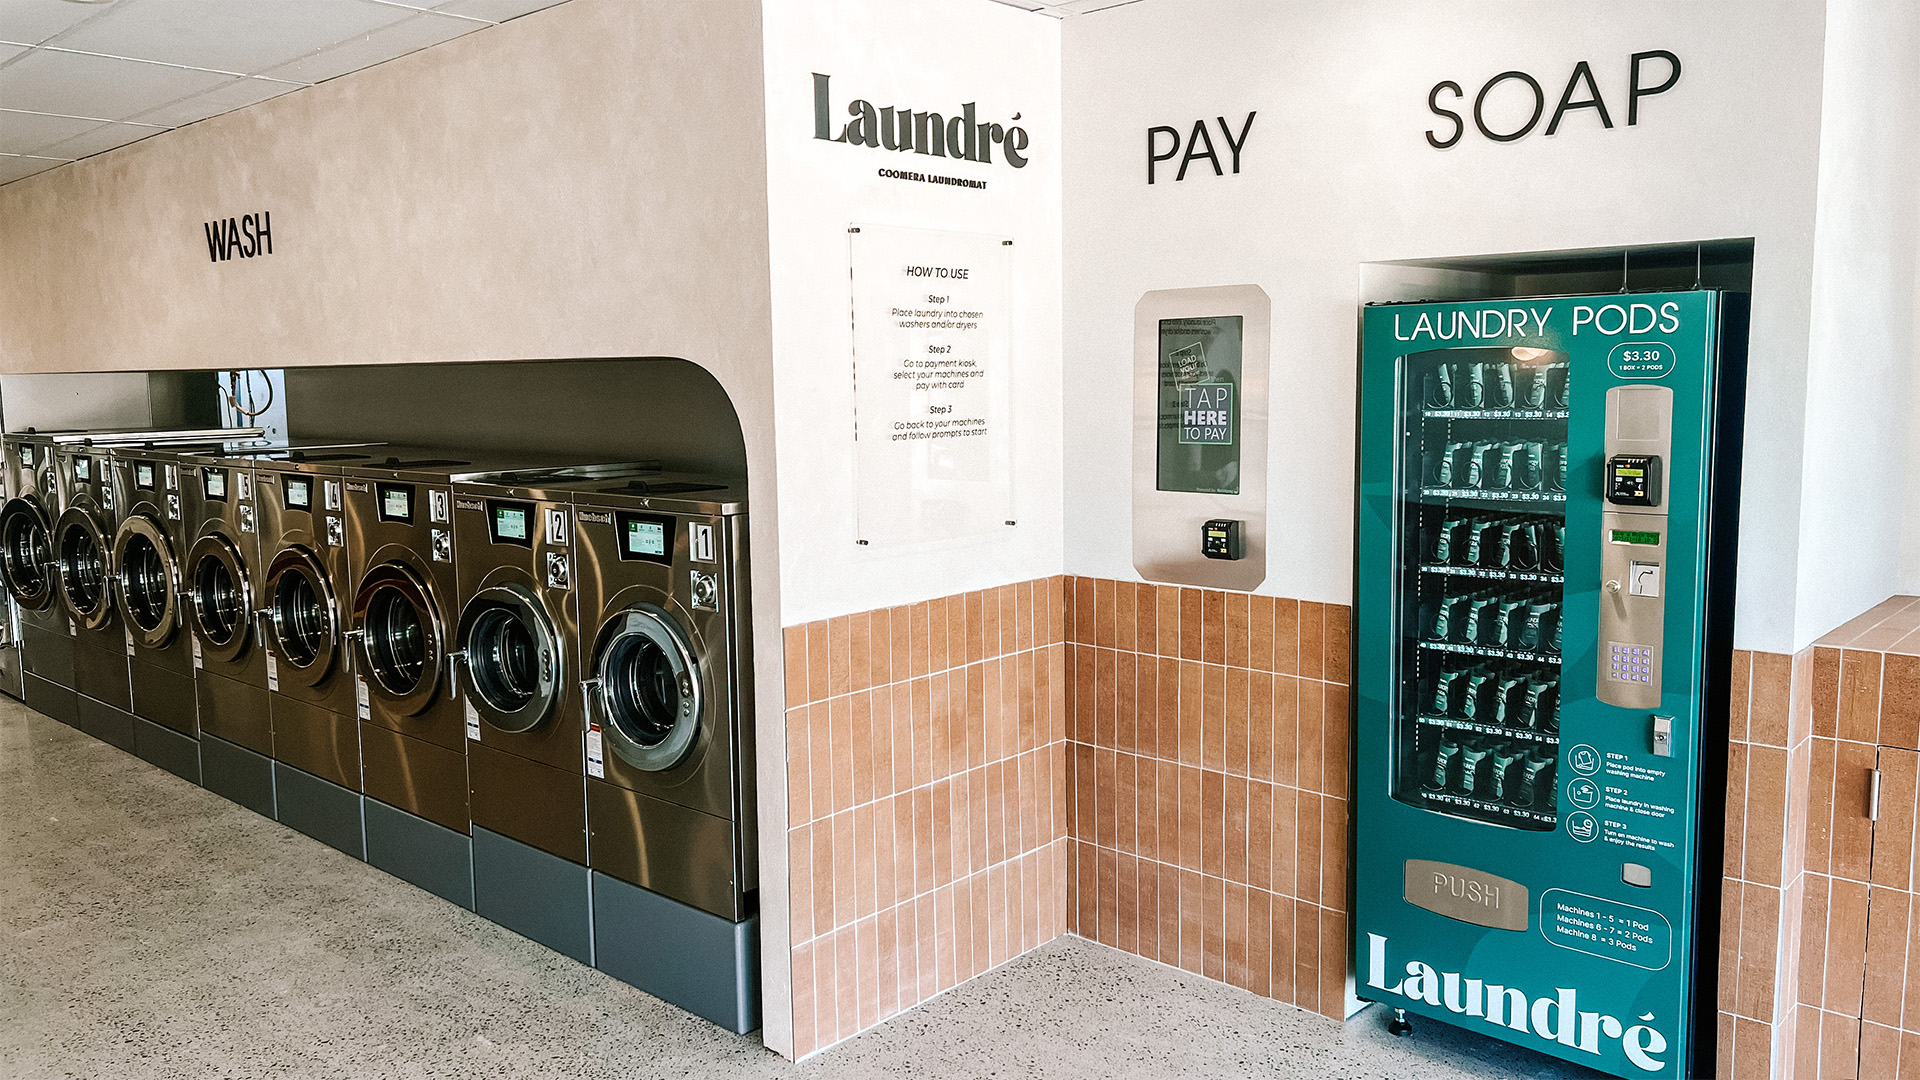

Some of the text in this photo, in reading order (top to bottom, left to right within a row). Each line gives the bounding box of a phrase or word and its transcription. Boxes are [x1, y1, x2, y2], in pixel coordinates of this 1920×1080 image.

[1425, 49, 1682, 149] SOAP
[811, 72, 1029, 168] Laundré
[1147, 111, 1257, 184] PAY
[878, 168, 987, 189] COOMERA LAUNDROMAT
[204, 211, 272, 262] WASH
[906, 266, 969, 280] HOW TO USE
[928, 294, 950, 304] Step 1
[892, 308, 984, 320] Place laundry into chosen
[1394, 301, 1680, 341] LAUNDRY PODS
[899, 320, 978, 331] washers and/or dryers
[928, 345, 952, 355] Step 2
[1623, 350, 1660, 362] $3.30
[903, 359, 914, 368] Go
[915, 360, 923, 368] to
[924, 360, 957, 370] payment
[1178, 354, 1197, 368] LOAD
[893, 370, 984, 381] select your machines and
[916, 381, 964, 391] pay with card
[1184, 387, 1228, 409] TAP
[929, 405, 952, 415] Step 3
[894, 418, 985, 430] Go back to your machines
[1184, 410, 1227, 426] HERE
[892, 432, 907, 441] and
[908, 431, 931, 440] follow
[931, 429, 962, 439] prompts
[971, 428, 987, 436] start
[1184, 427, 1227, 440] TO PAY
[244, 476, 249, 496] 5
[333, 485, 337, 506] 4
[437, 495, 444, 518] 3
[554, 514, 563, 540] 2
[701, 529, 709, 557] 1
[1487, 649, 1504, 657] $3.30
[1517, 653, 1534, 661] $3.30
[1486, 727, 1502, 735] $3.30
[1515, 732, 1532, 740] $3.30
[1606, 752, 1623, 760] STEP
[1606, 761, 1621, 769] Place
[1647, 769, 1666, 777] empty
[1606, 769, 1654, 781] washing machine
[1605, 786, 1622, 794] STEP
[1604, 802, 1628, 811] machine
[1605, 795, 1620, 803] Place
[1621, 798, 1643, 808] laundry
[1650, 804, 1675, 814] washing
[1604, 820, 1621, 828] STEP
[1626, 834, 1650, 843] machine
[1658, 840, 1675, 848] wash
[1636, 843, 1655, 851] results
[1433, 871, 1500, 909] PUSH
[1557, 902, 1595, 918] Machines
[1596, 912, 1600, 920] 1
[1608, 915, 1614, 923] 5
[1626, 919, 1630, 927] 1
[1632, 920, 1649, 931] Pod
[1556, 914, 1594, 929] Machines
[1595, 923, 1602, 931] 6
[1609, 926, 1615, 934] 7
[1624, 930, 1630, 939] 2
[1632, 932, 1653, 944] Pods
[1556, 925, 1590, 940] Machine
[1591, 934, 1597, 942] 8
[1608, 938, 1614, 946] 3
[1616, 940, 1637, 951] Pods
[1366, 932, 1668, 1072] Laundré
